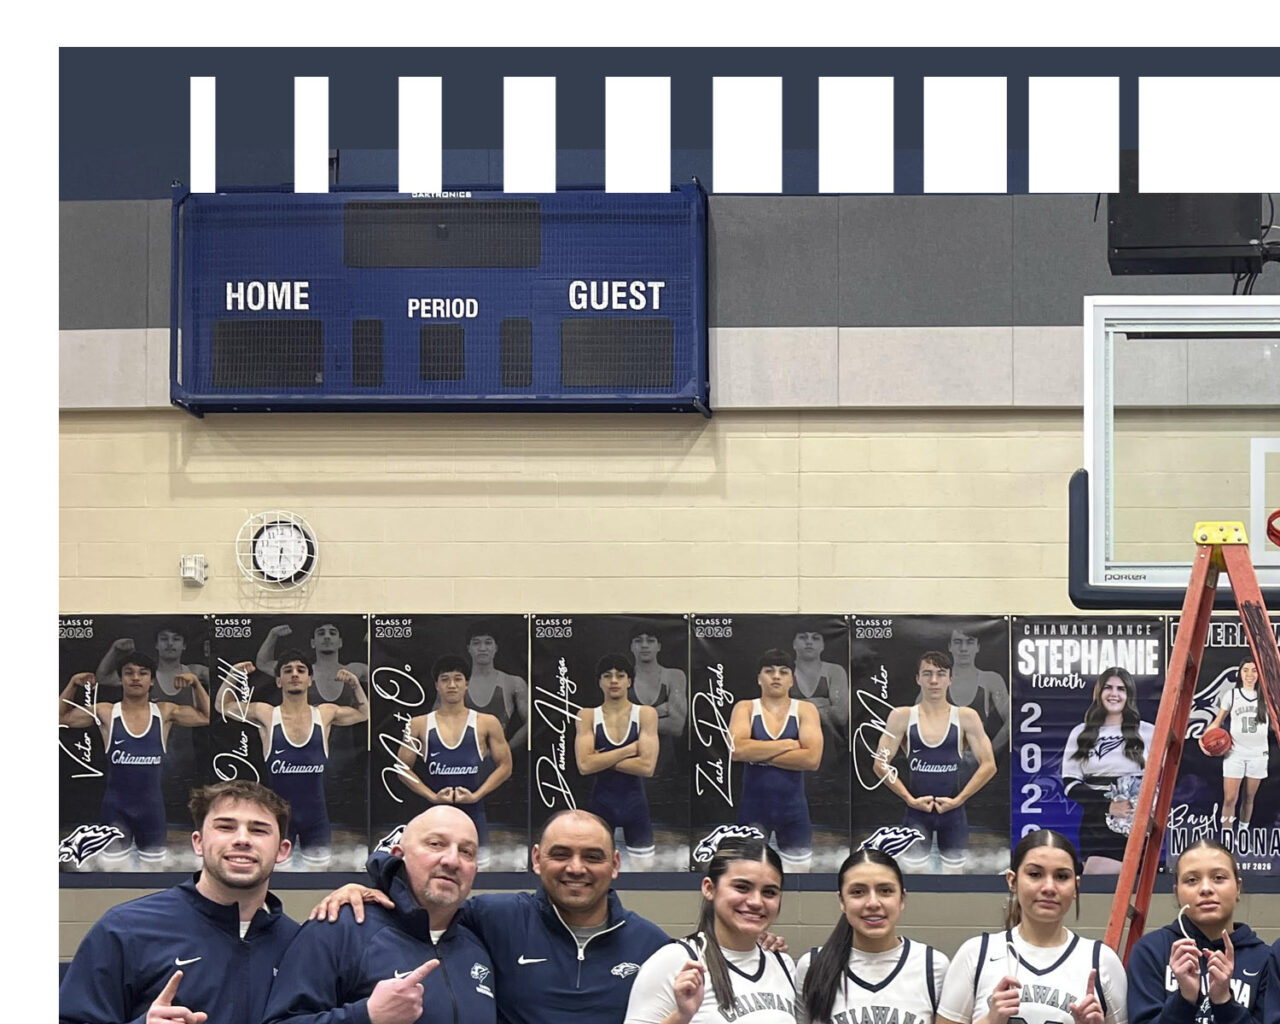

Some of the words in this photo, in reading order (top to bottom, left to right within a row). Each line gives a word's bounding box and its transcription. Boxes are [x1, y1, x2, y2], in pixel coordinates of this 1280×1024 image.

[225, 281, 310, 311] HOME
[568, 280, 665, 311] GUEST
[407, 298, 479, 319] PERIOD
[214, 618, 239, 626] CLASS
[241, 618, 252, 626] OF
[375, 618, 400, 626] CLASS
[401, 618, 412, 626] OF
[535, 618, 561, 626] CLASS
[562, 618, 573, 626] OF
[695, 618, 720, 626] CLASS
[721, 618, 733, 626] OF
[855, 619, 880, 627] CLASS
[882, 619, 893, 627] OF
[59, 627, 94, 639] 2026
[214, 626, 252, 638] 2026
[375, 626, 412, 638] 2026
[535, 626, 573, 638] 2026
[695, 626, 733, 638] 2026
[855, 627, 893, 639] 2026
[1024, 624, 1098, 636] CHIAWANA
[1107, 624, 1152, 636] DANCE
[1017, 638, 1160, 676] STEPHANIE
[1032, 672, 1086, 689] Nemeth
[62, 680, 101, 726] Luna
[691, 663, 735, 752] Delgado
[1241, 716, 1258, 734] 15
[111, 749, 161, 765] Chiawana
[270, 759, 325, 774] Chiawana
[429, 761, 479, 775] Chiawana
[910, 757, 958, 773] Chiawana
[695, 750, 734, 807] Zach
[1166, 802, 1238, 836] Baylee
[1242, 862, 1252, 871] OF
[1252, 862, 1272, 871] 2026
